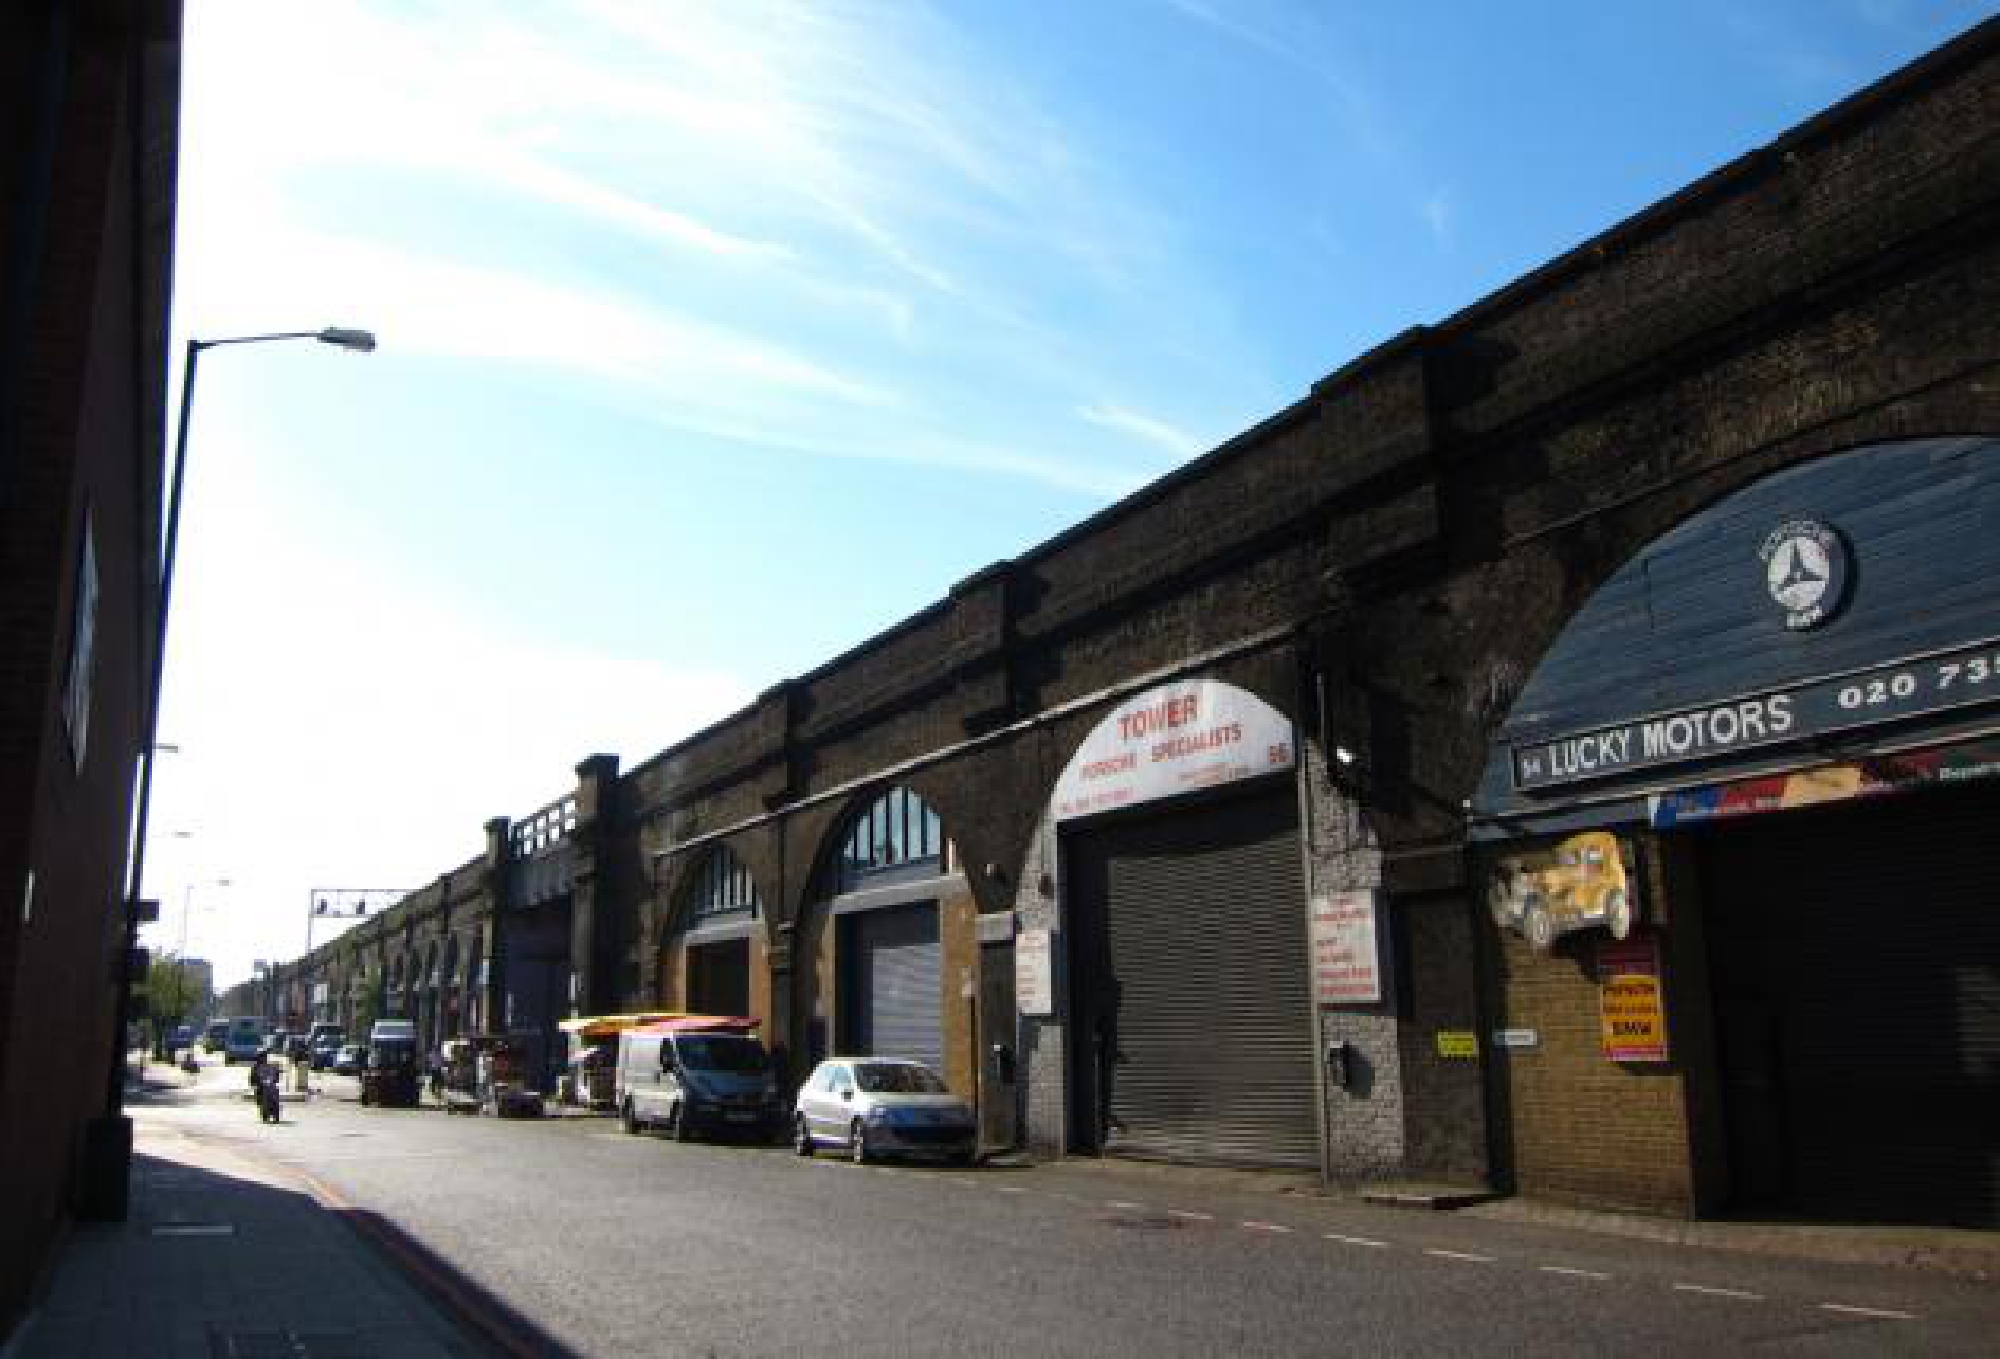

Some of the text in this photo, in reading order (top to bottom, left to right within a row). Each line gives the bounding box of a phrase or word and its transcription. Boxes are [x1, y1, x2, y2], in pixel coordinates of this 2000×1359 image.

[1116, 693, 1198, 744] TOWER
[1151, 722, 1242, 763] SPECIALISTS
[1550, 728, 1630, 776] LUCKY
[1643, 694, 1792, 757] MOTORS
[1838, 672, 1917, 709] 020
